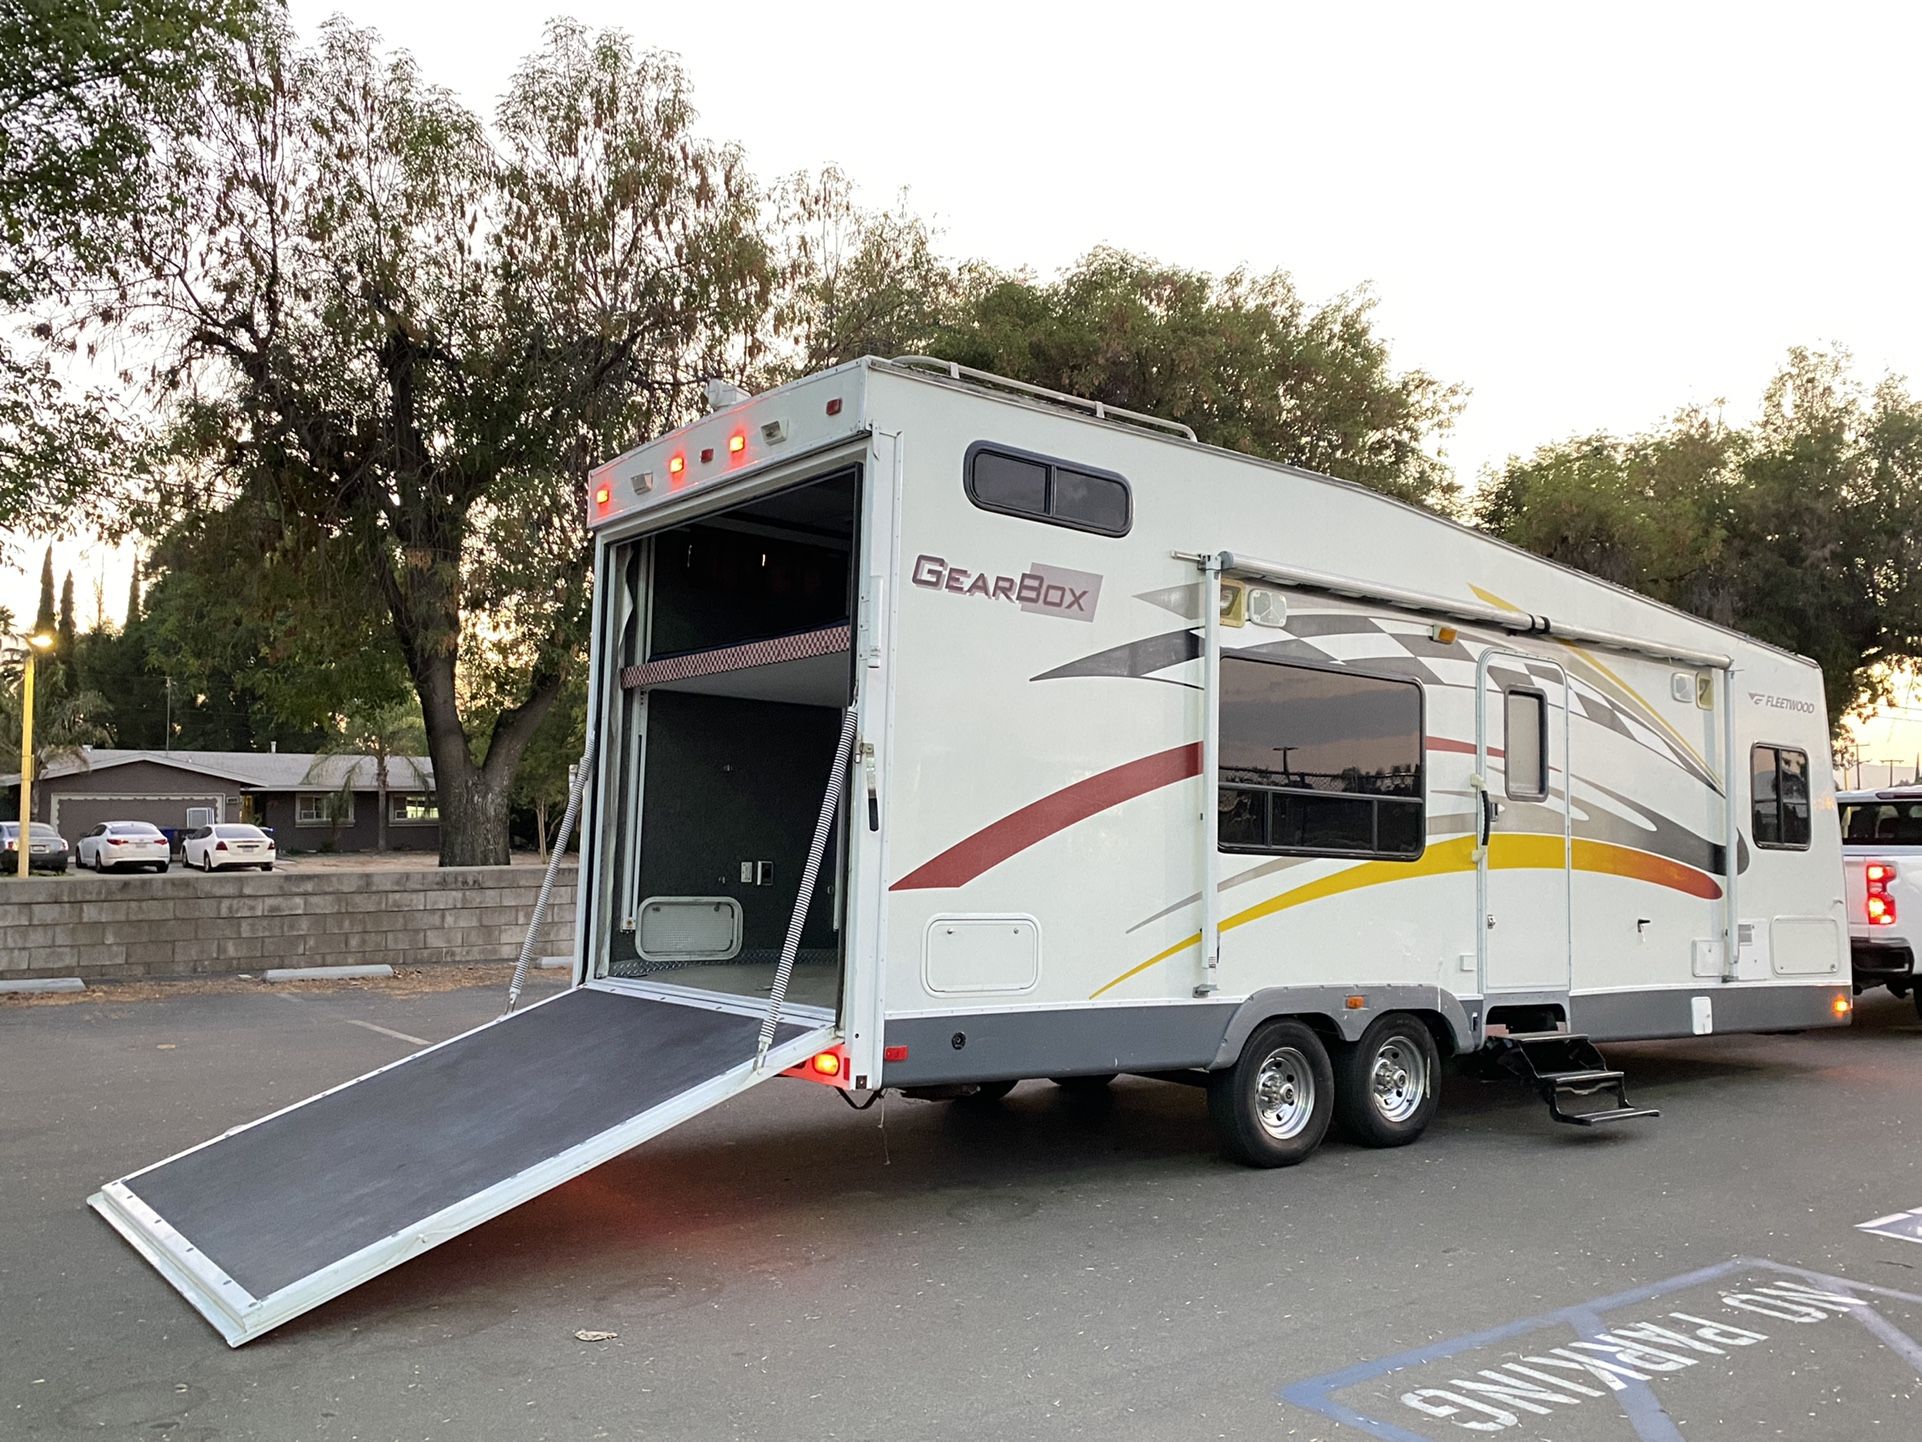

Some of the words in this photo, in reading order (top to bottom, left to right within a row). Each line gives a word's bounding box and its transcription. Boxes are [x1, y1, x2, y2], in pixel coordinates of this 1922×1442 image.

[1765, 695, 1815, 714] FLEETWOOD
[1721, 1281, 1868, 1324] NO
[1401, 1312, 1769, 1432] PARKING
